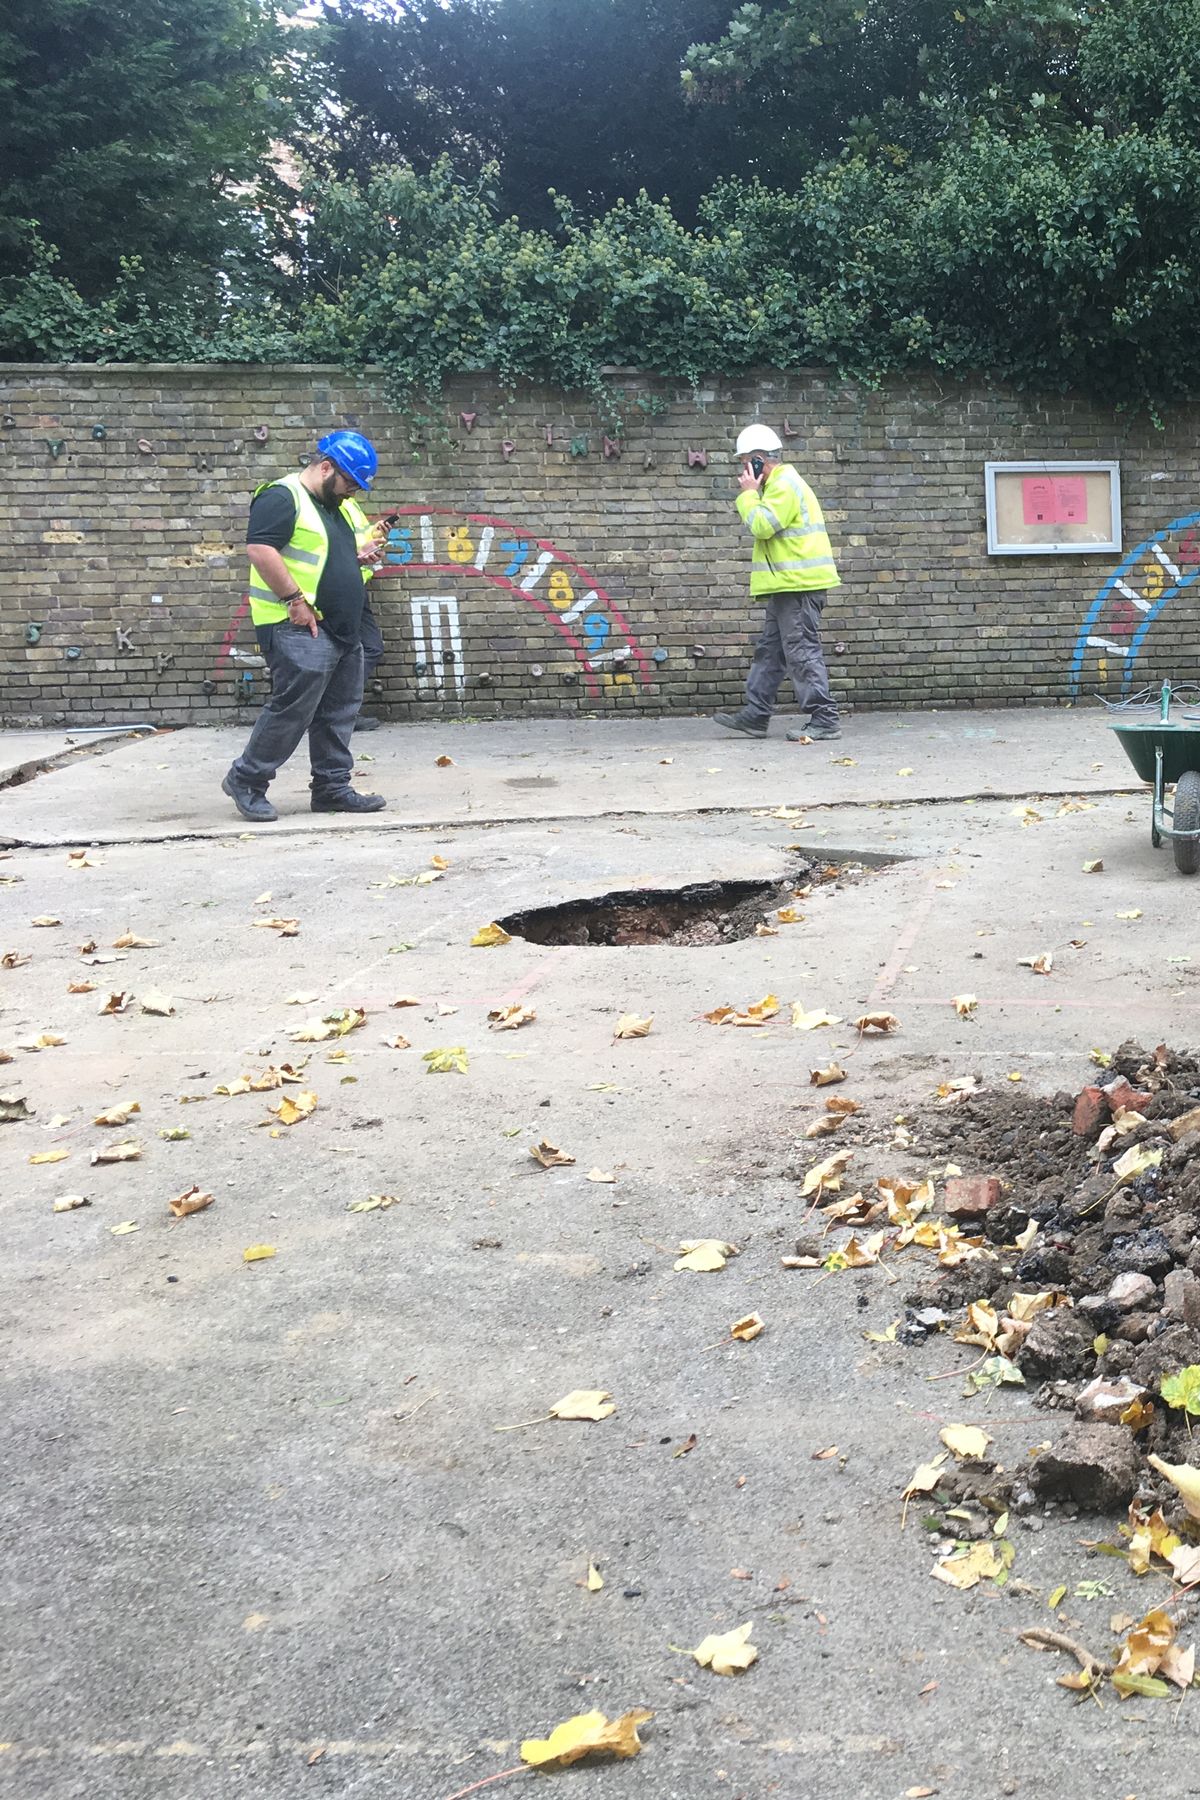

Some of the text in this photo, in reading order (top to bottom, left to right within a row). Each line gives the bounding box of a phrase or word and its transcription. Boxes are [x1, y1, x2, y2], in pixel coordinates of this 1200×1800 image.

[386, 528, 413, 564] 5
[447, 525, 475, 563] 6
[500, 541, 529, 577] 7
[548, 570, 575, 609] 8
[584, 613, 609, 653] 9
[1143, 564, 1164, 598] 3
